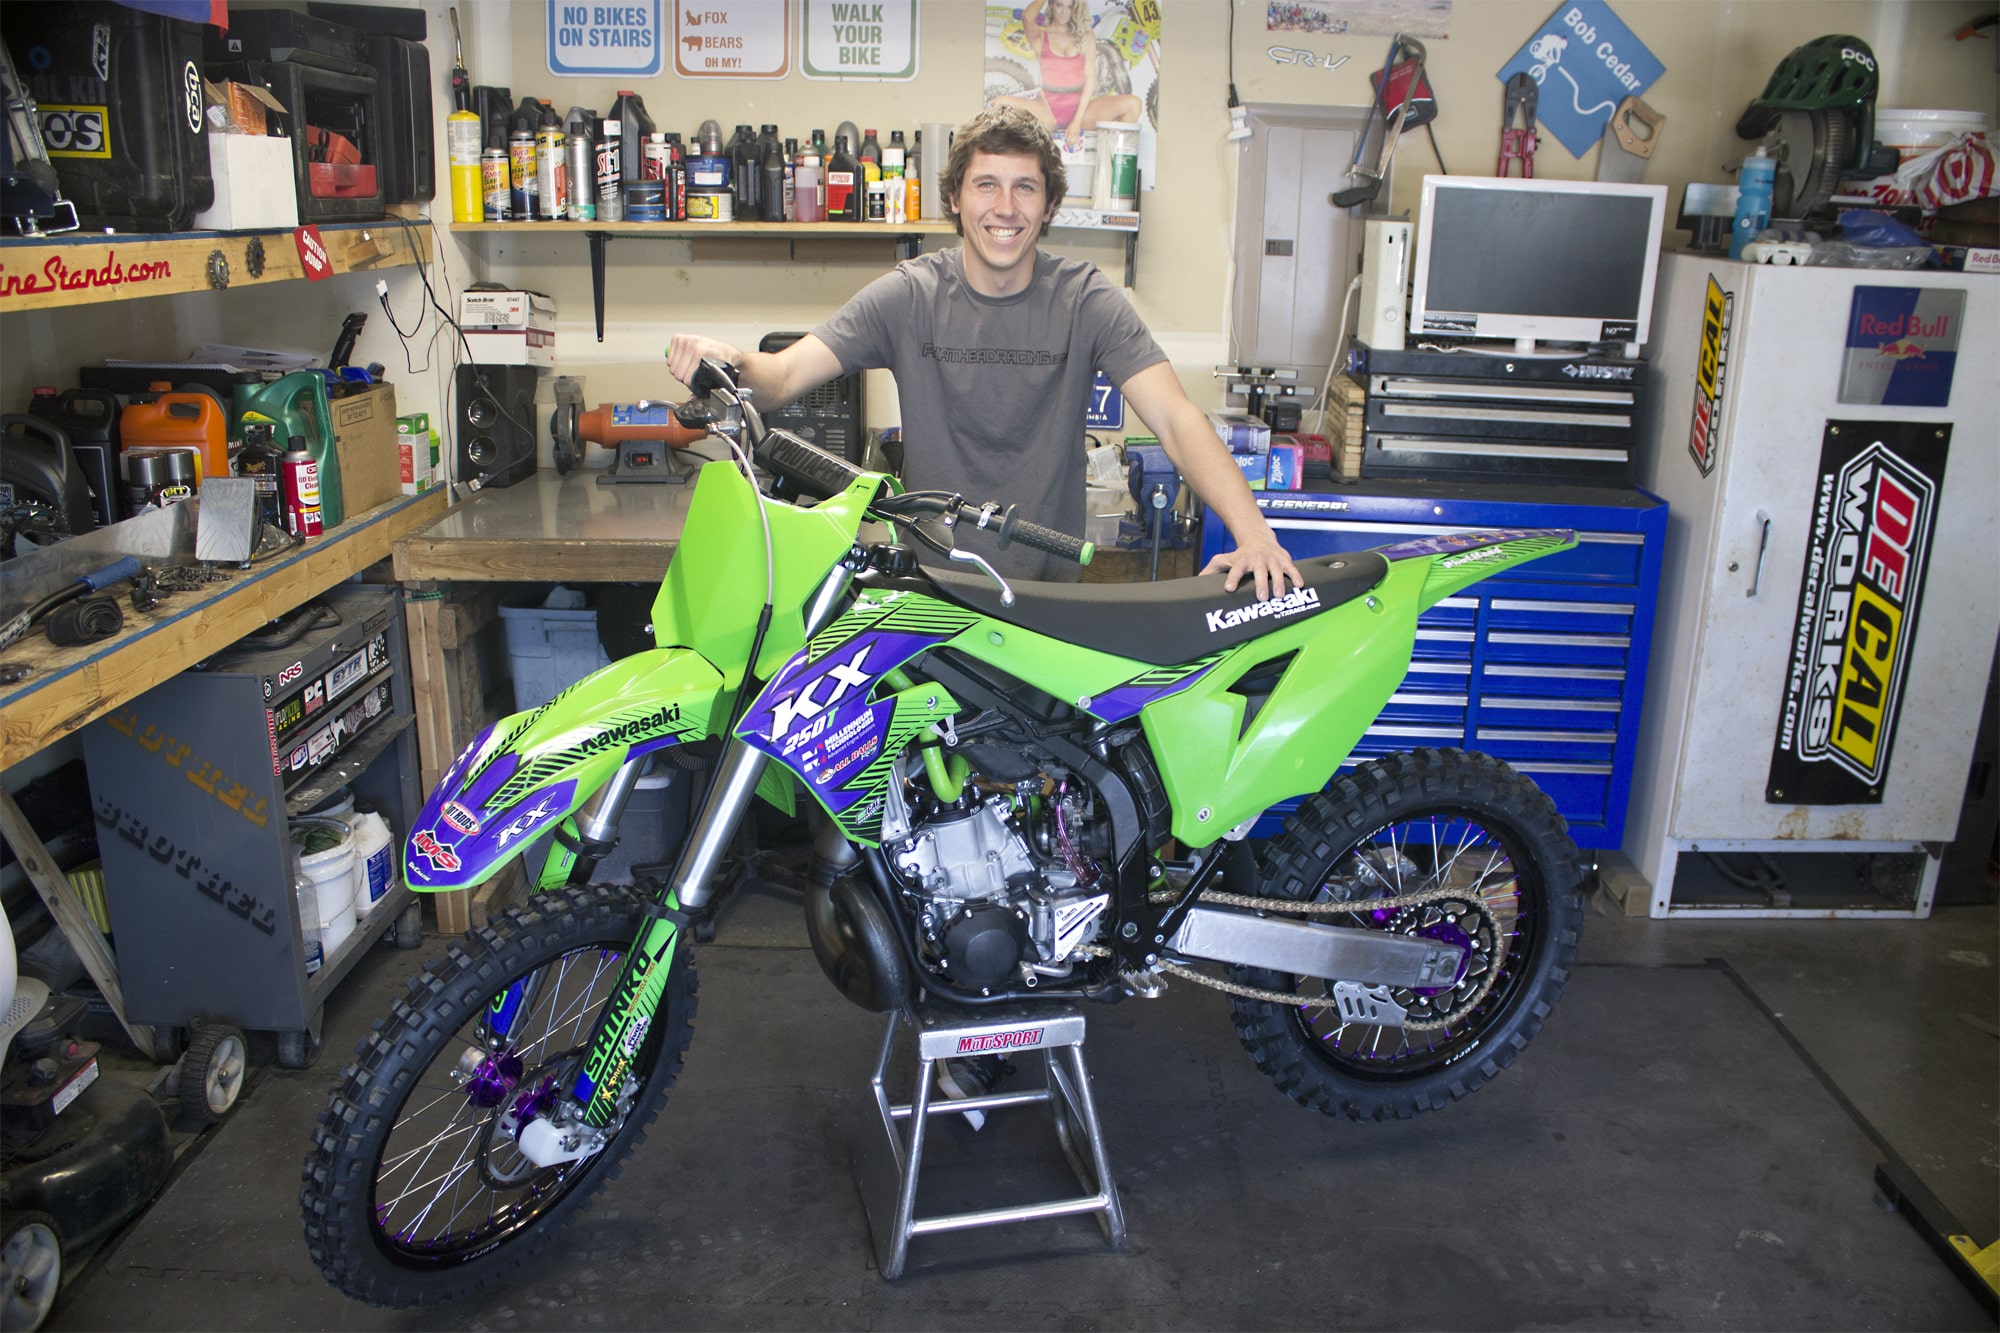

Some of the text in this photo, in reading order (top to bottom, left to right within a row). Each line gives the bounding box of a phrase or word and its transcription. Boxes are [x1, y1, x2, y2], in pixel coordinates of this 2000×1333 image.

[563, 7, 647, 27] NO BIKES
[704, 11, 728, 25] FOX
[832, 3, 883, 22] WALK
[559, 28, 652, 48] ON STAIRS
[704, 36, 743, 49] BEARS
[833, 25, 882, 44] YOUR
[1563, 6, 1643, 92] Bob Cedar
[705, 57, 742, 68] OH MY!
[839, 47, 881, 65] BIKE
[1267, 45, 1351, 71] CR-V
[187, 71, 200, 122] bca
[482, 163, 494, 171] uto
[597, 149, 620, 177] SC1
[302, 229, 327, 265] CAUTION
[304, 249, 323, 272] JUMP
[1860, 313, 1949, 338] Red Bull
[1578, 364, 1635, 380] HUSKY
[1271, 455, 1284, 485] Ziploc
[1271, 500, 1350, 512] GENERAL
[1206, 587, 1319, 633] Kawasaki
[1780, 473, 1834, 750] www.decalworks.com
[1807, 461, 1873, 749] WORKS
[1836, 470, 1920, 750] DECAL
[279, 663, 303, 683] NRS
[304, 680, 322, 703] PC
[771, 645, 873, 744] KX
[580, 702, 680, 753] Kawasaki
[782, 706, 839, 757] 250T
[825, 708, 873, 747] MILLENNIUM
[826, 715, 875, 754] TECHNOLOGIES
[833, 735, 878, 773] ALL BALLS
[455, 808, 476, 830] RODS
[494, 793, 555, 851] KX
[415, 832, 461, 870] IMS
[627, 962, 656, 1014] MOTORCYCLE TIRES
[585, 952, 651, 1082] SHINKO
